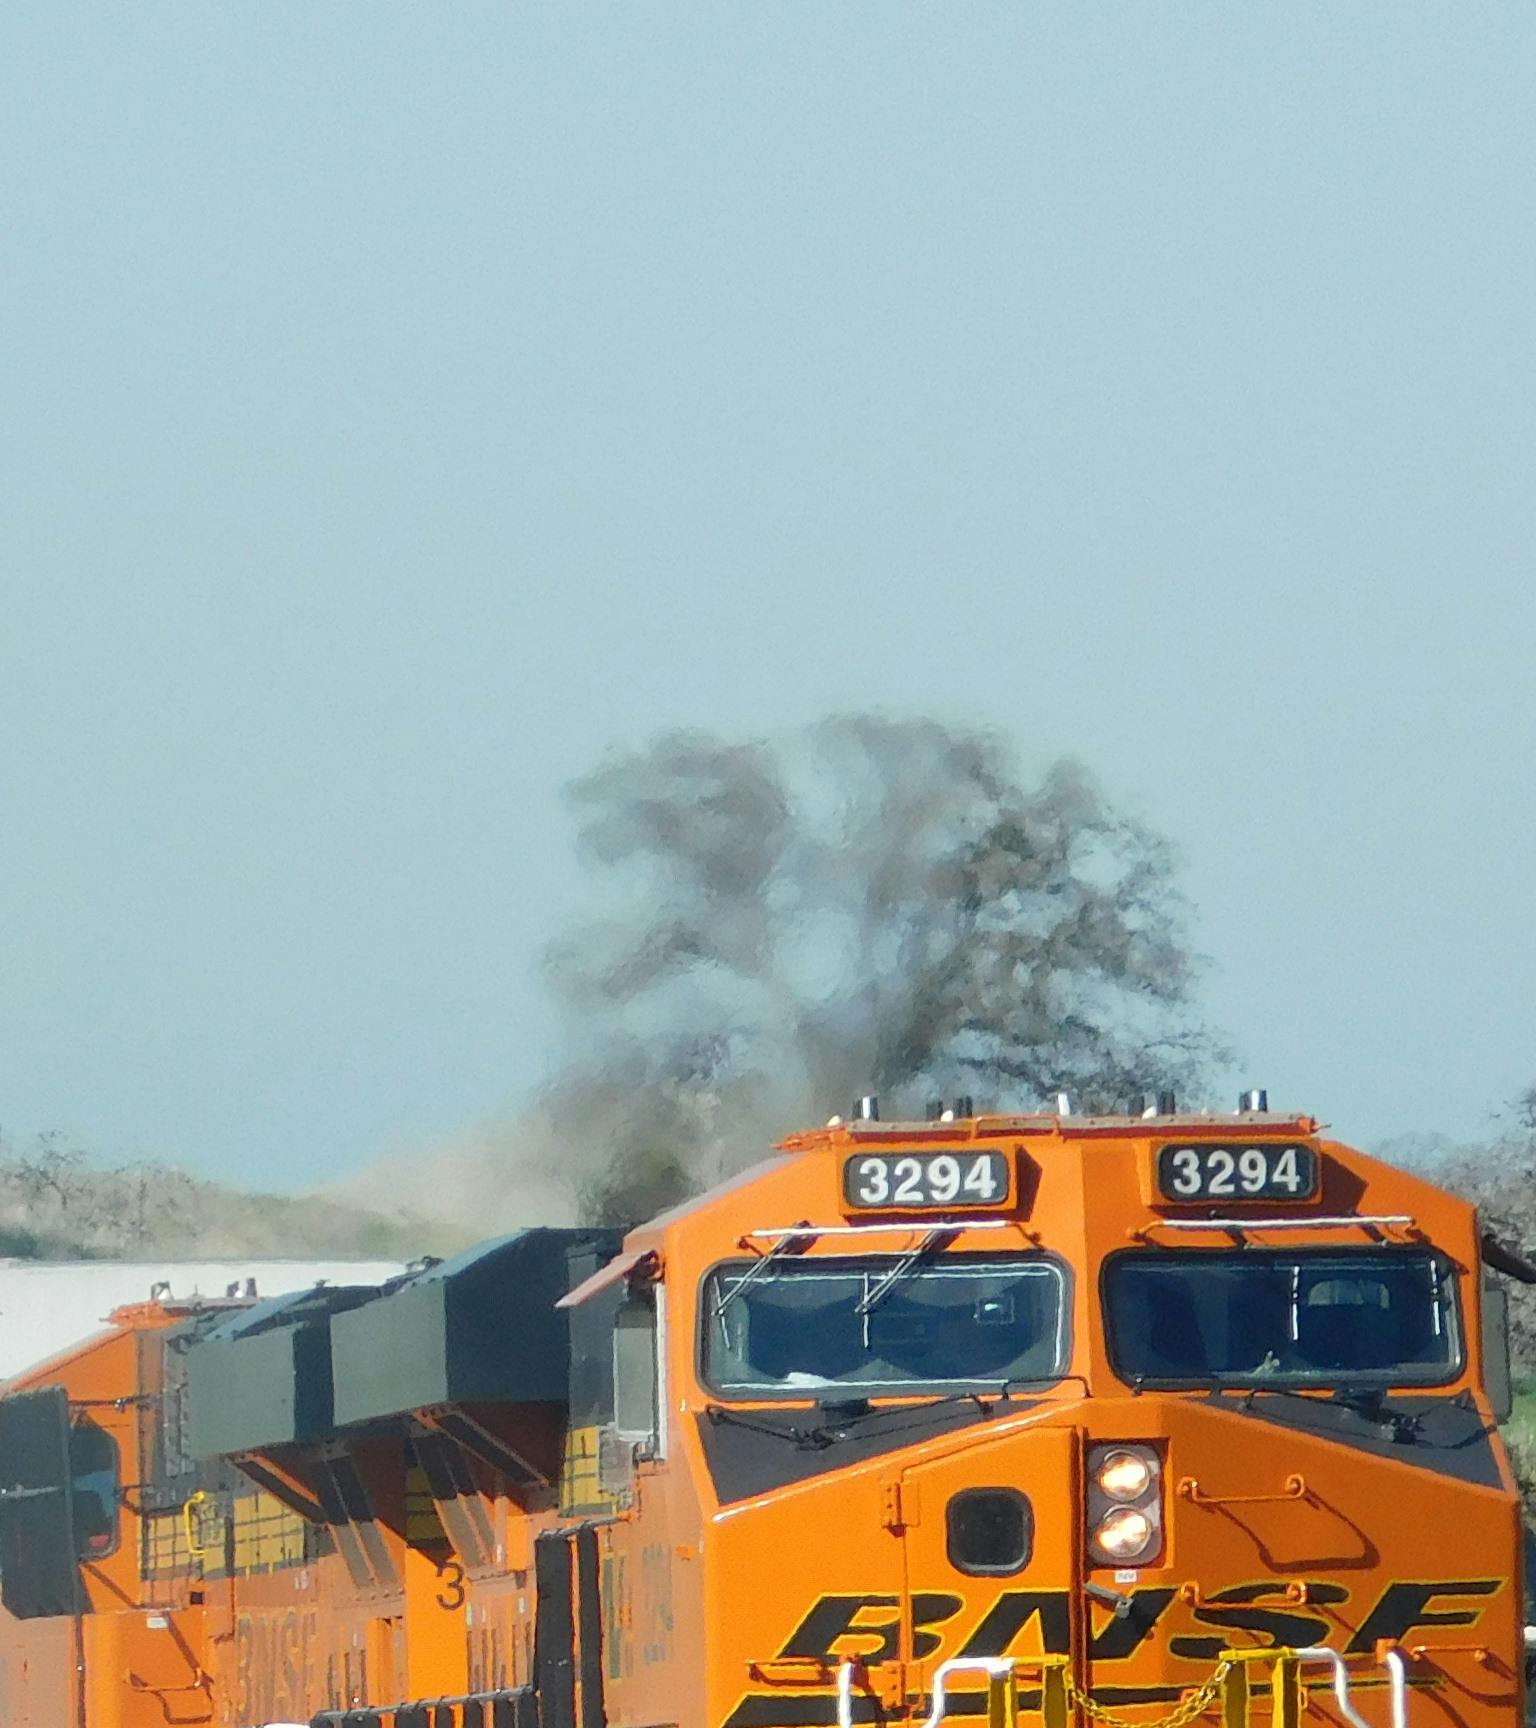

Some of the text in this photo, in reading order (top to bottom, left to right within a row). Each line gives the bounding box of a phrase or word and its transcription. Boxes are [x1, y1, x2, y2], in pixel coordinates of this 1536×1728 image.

[859, 1154, 997, 1203] 3294
[1172, 1149, 1301, 1195] 3294
[772, 1577, 1508, 1668] BNSF
